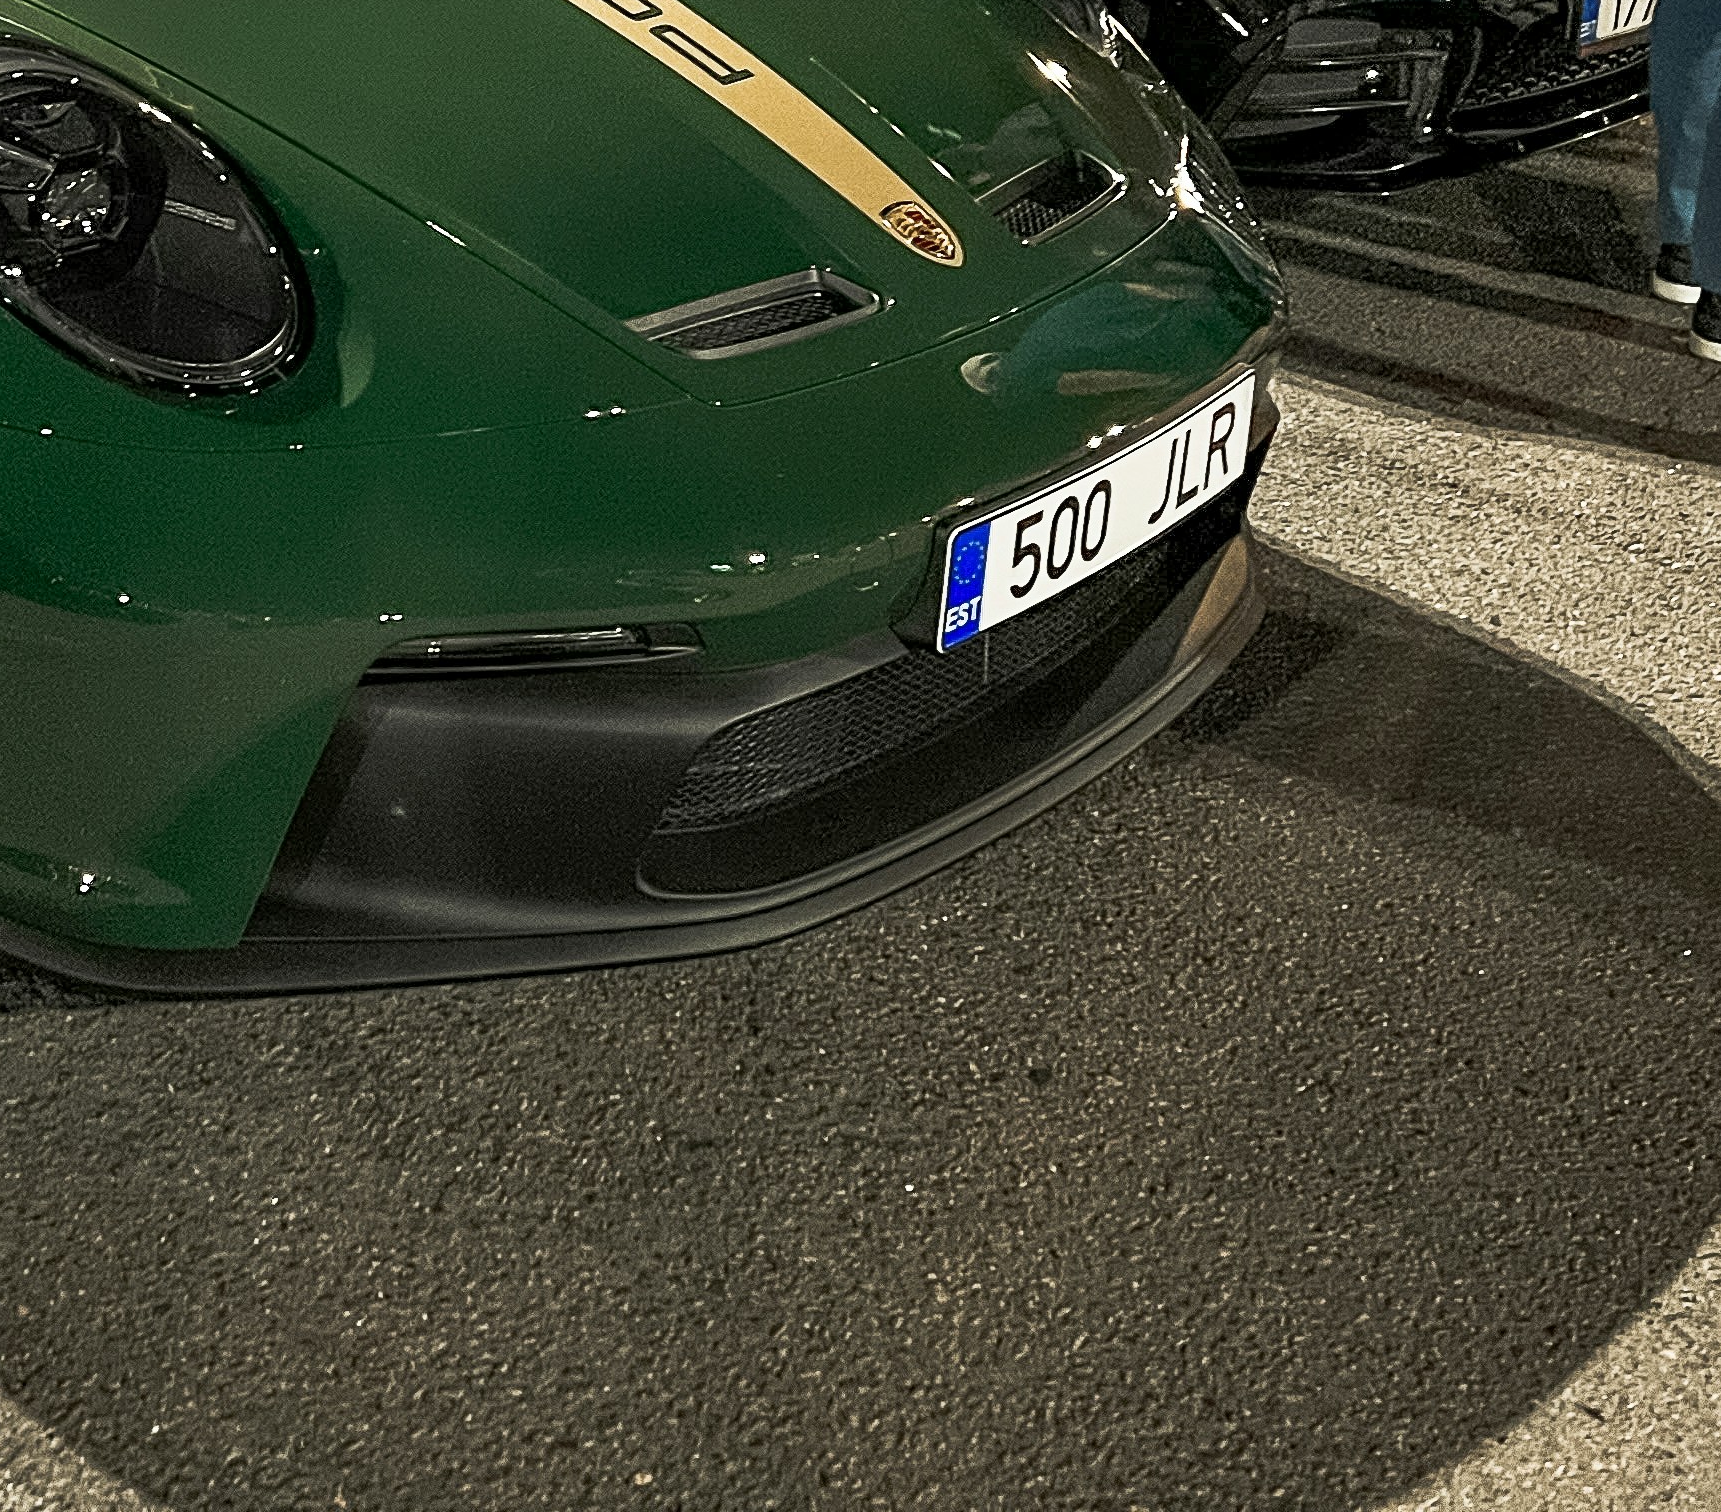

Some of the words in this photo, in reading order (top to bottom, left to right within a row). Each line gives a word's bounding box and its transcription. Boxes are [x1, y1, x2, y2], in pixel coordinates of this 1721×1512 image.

[1010, 479, 1112, 599] 500
[1147, 402, 1236, 525] JLR
[944, 595, 982, 633] EST
